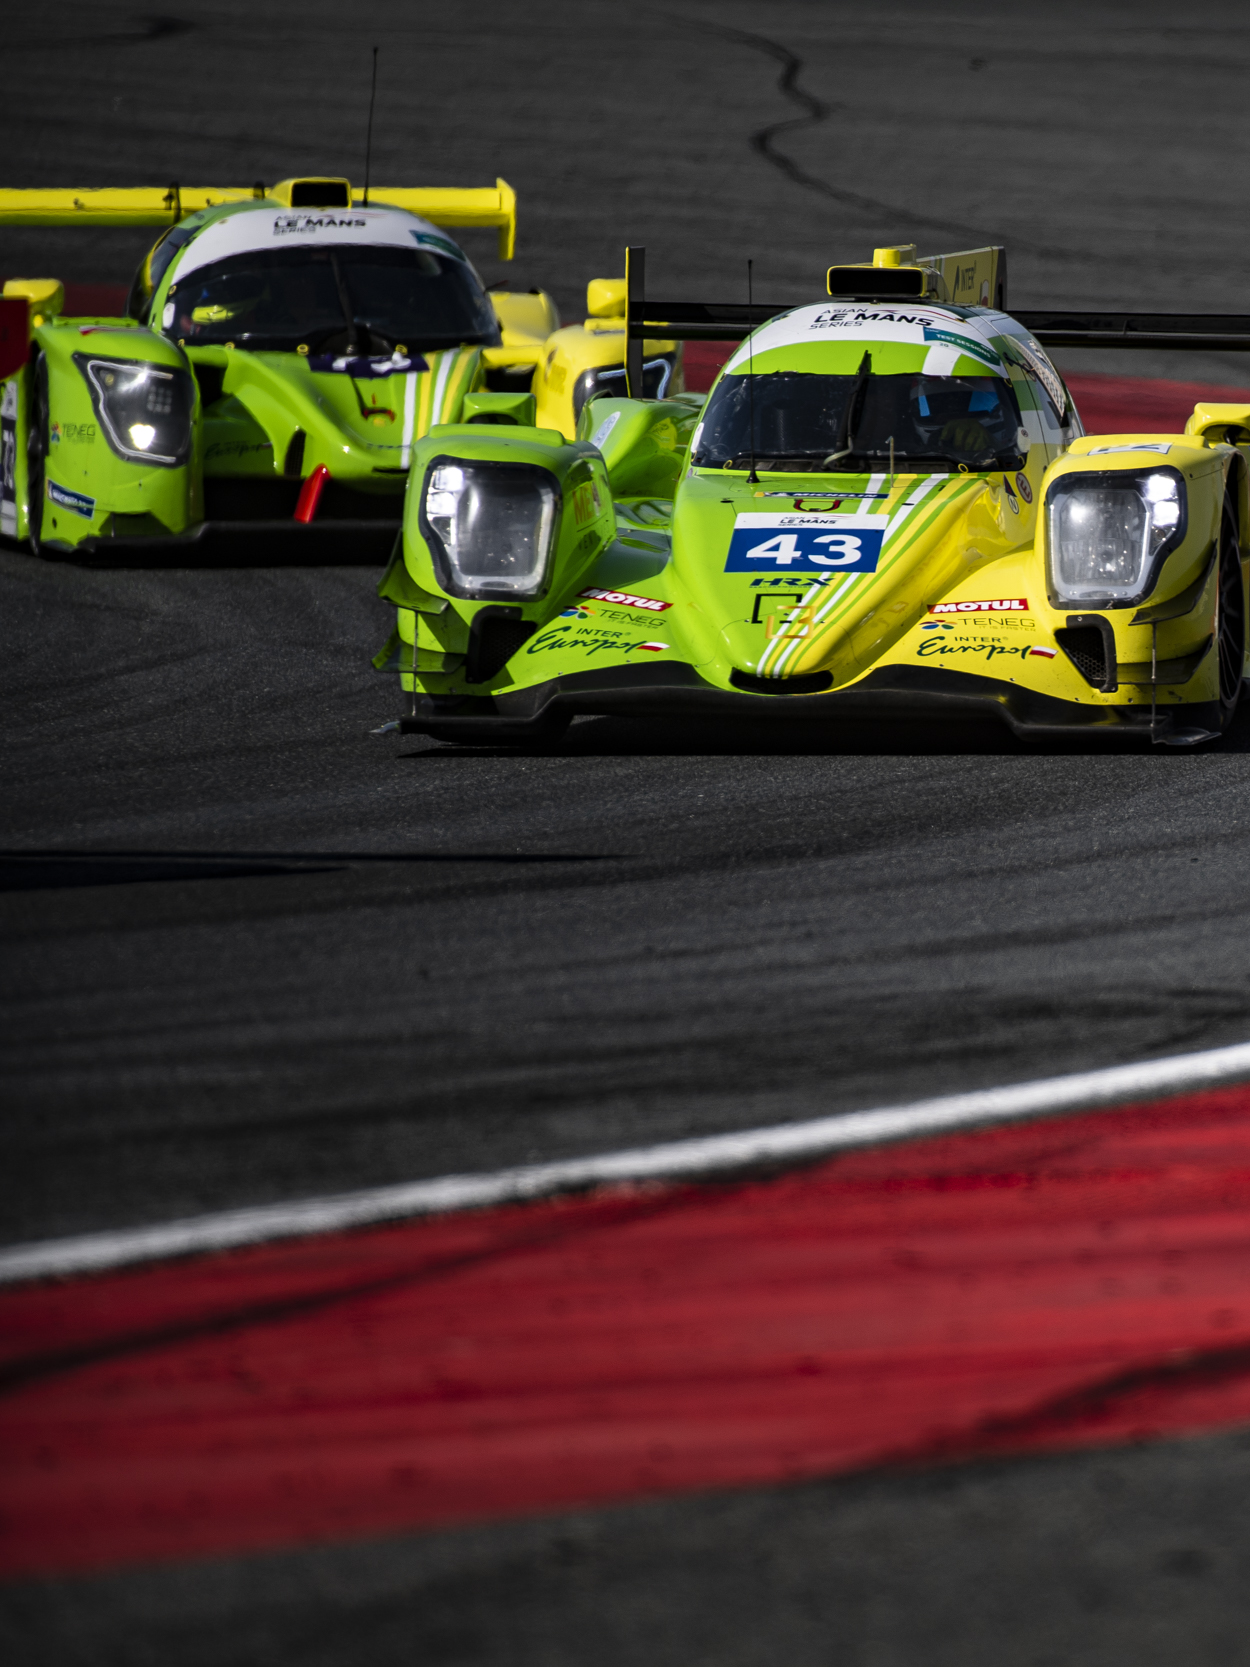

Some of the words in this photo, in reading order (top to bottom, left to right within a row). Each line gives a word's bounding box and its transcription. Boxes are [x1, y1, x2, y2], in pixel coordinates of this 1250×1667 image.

[274, 219, 297, 228] LE
[306, 218, 366, 228] MANS
[809, 321, 863, 330] SERIES
[814, 313, 848, 323] LE
[854, 313, 935, 327] MANS
[936, 333, 956, 342] TEST
[956, 339, 991, 358] SESSIONS
[62, 423, 96, 438] TENEG
[746, 534, 862, 566] 43
[750, 578, 835, 586] HRX
[582, 588, 666, 611] MOTUL
[933, 600, 1025, 613] MOTUL
[599, 608, 667, 627] TENEG
[959, 618, 1035, 627] TENEG
[576, 627, 623, 638] INTER
[527, 626, 647, 656] Europol
[916, 636, 1032, 660] Europol
